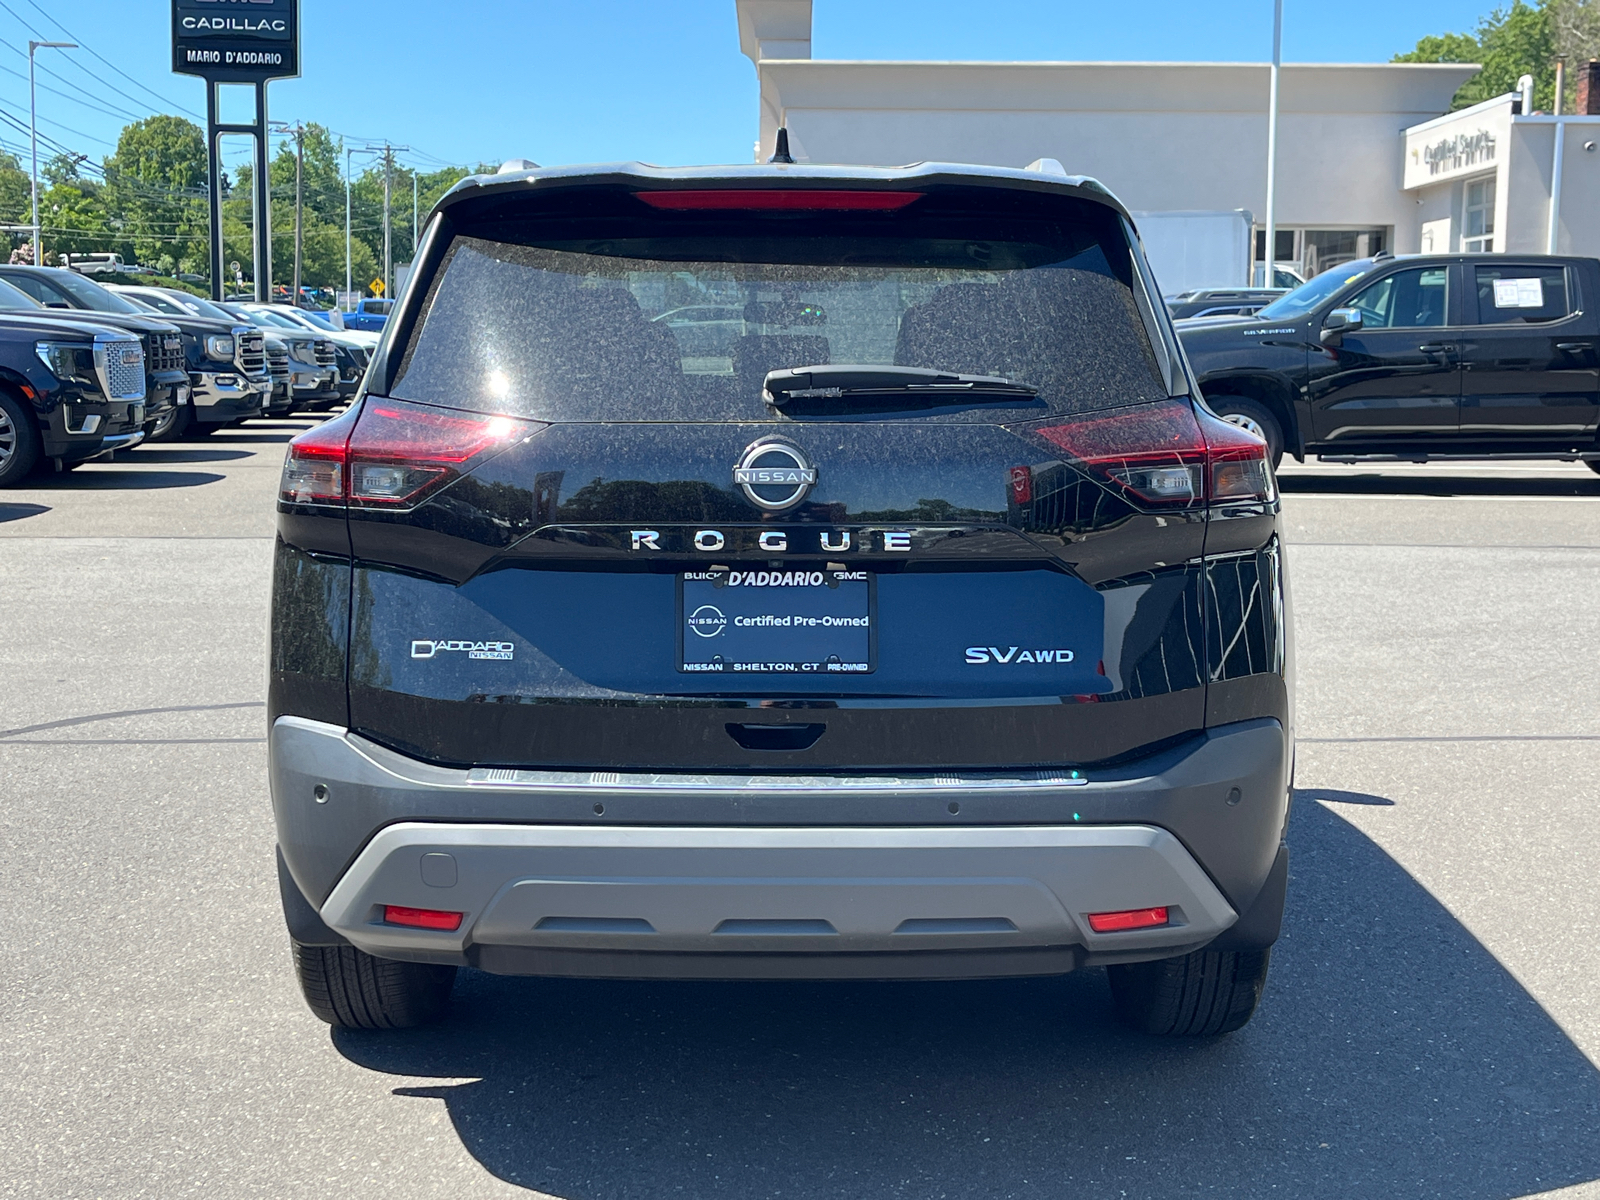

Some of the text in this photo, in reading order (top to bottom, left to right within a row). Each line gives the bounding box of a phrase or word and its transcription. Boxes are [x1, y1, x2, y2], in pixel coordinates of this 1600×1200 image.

[182, 17, 286, 31] CADILLAC
[186, 50, 282, 65] MARIO D'ADDARIO
[737, 472, 814, 482] NISSAN
[630, 530, 911, 552] ROGUE
[728, 571, 824, 587] D'ADDARIO
[833, 571, 867, 580] GMC
[734, 615, 869, 627] Certified Pre-Owned
[411, 640, 514, 658] D'ADDARIO
[965, 646, 1074, 664] SV AWD
[683, 663, 723, 671] NISSAN
[733, 663, 820, 672] SHELTON, CT
[827, 663, 868, 671] PRE-OWNED
